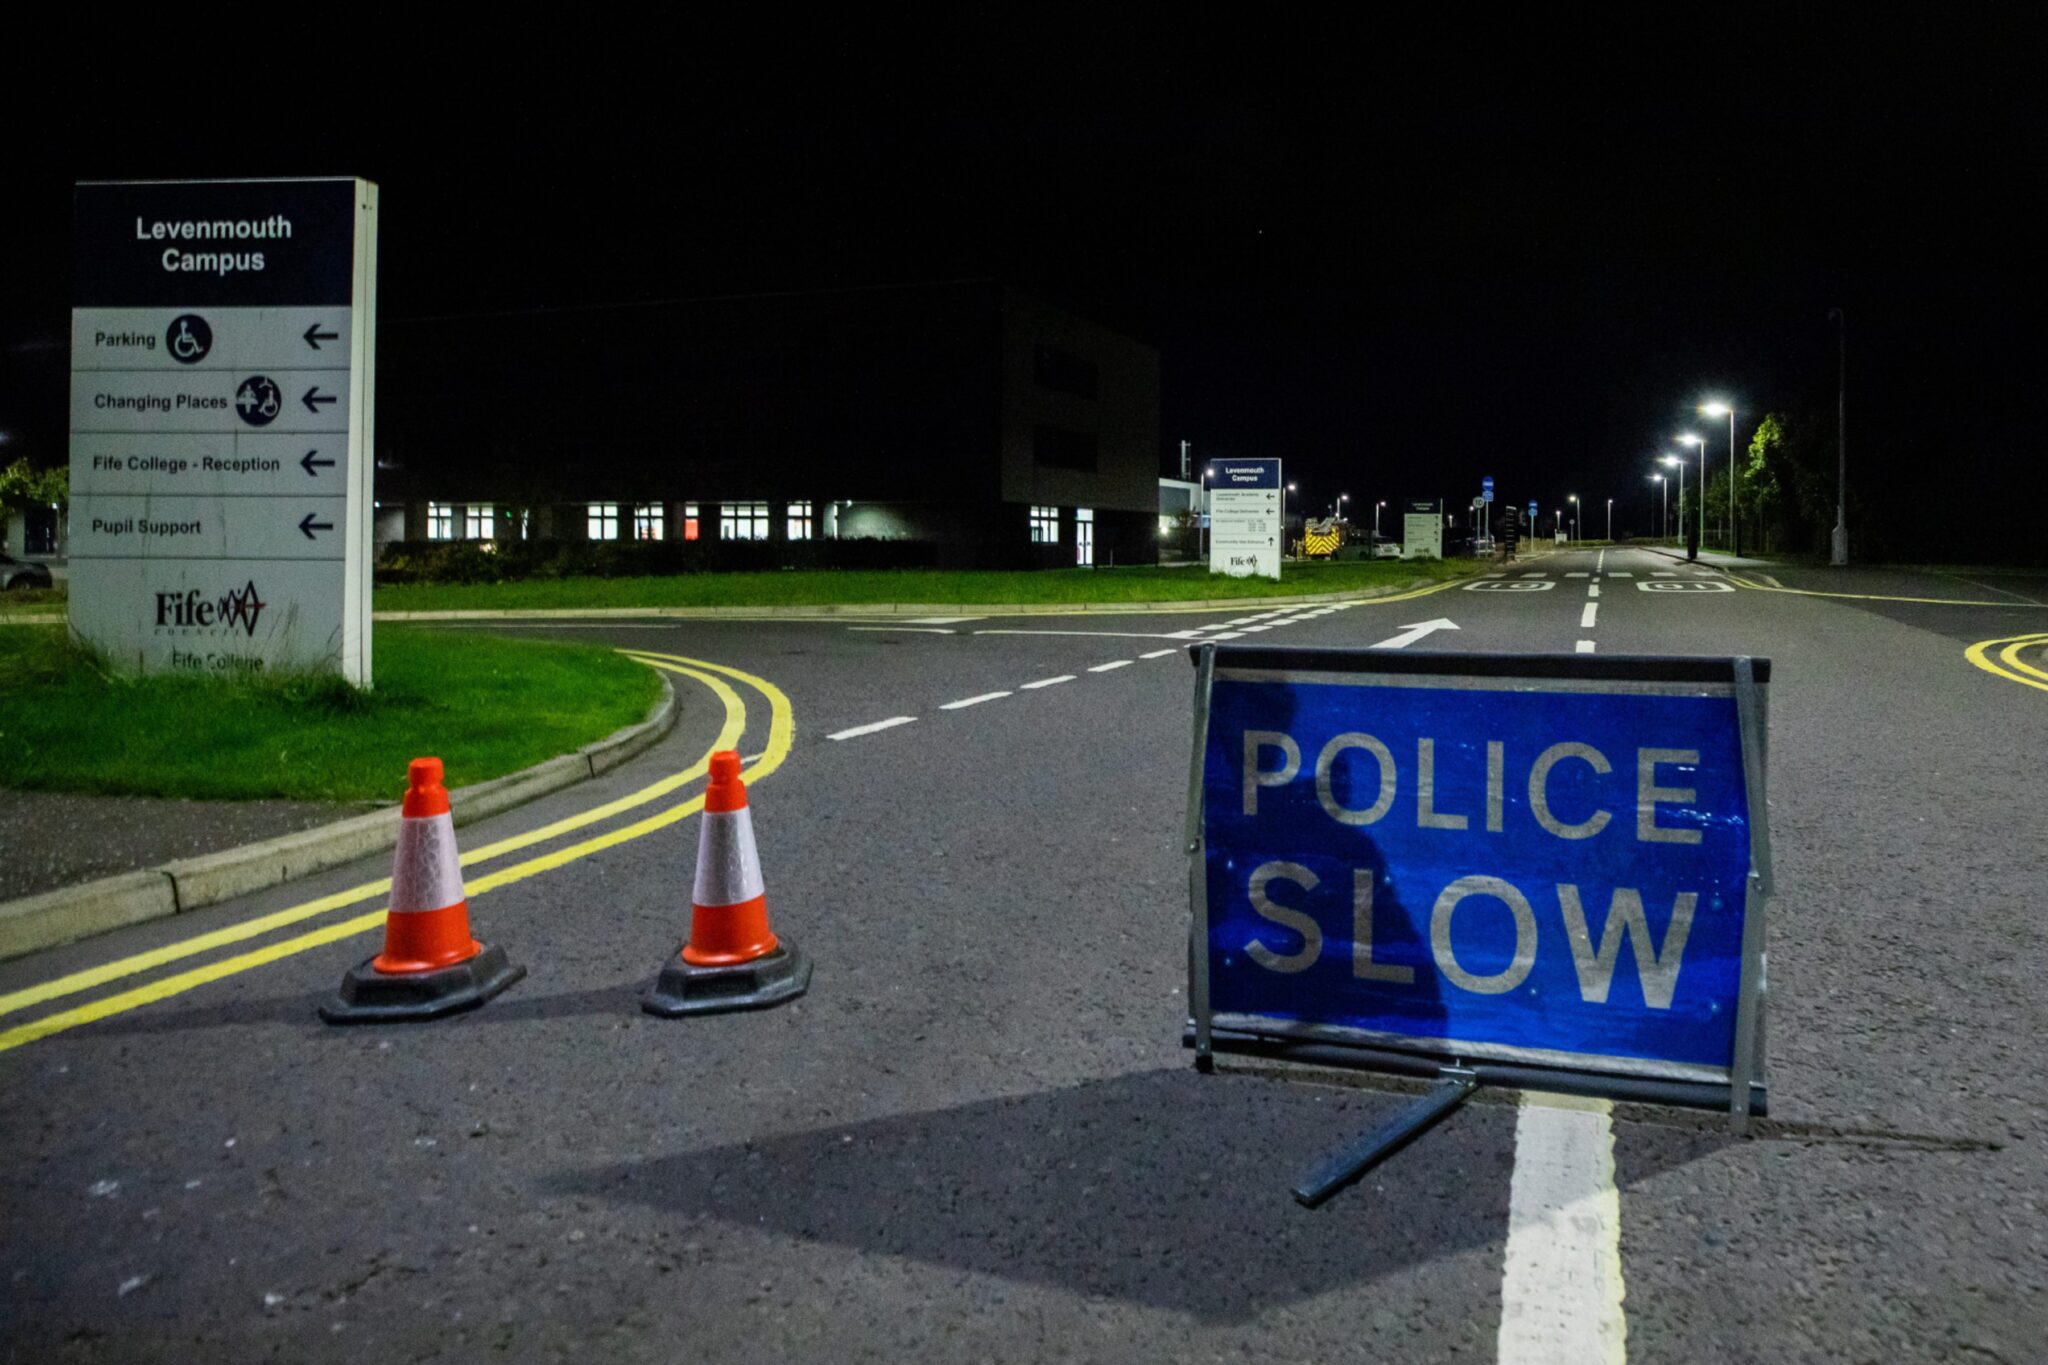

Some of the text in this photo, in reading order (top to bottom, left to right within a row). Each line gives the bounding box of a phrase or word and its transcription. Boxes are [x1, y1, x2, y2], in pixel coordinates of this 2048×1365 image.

[136, 214, 293, 240] Levenmouth
[161, 248, 266, 277] Campus
[94, 331, 157, 350] Parking
[93, 393, 228, 412] Changing Places
[92, 455, 124, 471] Fife
[127, 455, 188, 474] College
[202, 455, 281, 474] Reception
[92, 518, 202, 537] Pupil Support
[154, 589, 215, 627] Fife
[172, 651, 202, 669] Fife
[1242, 729, 1703, 845] POLICE
[1243, 859, 1699, 1010] SLOW
